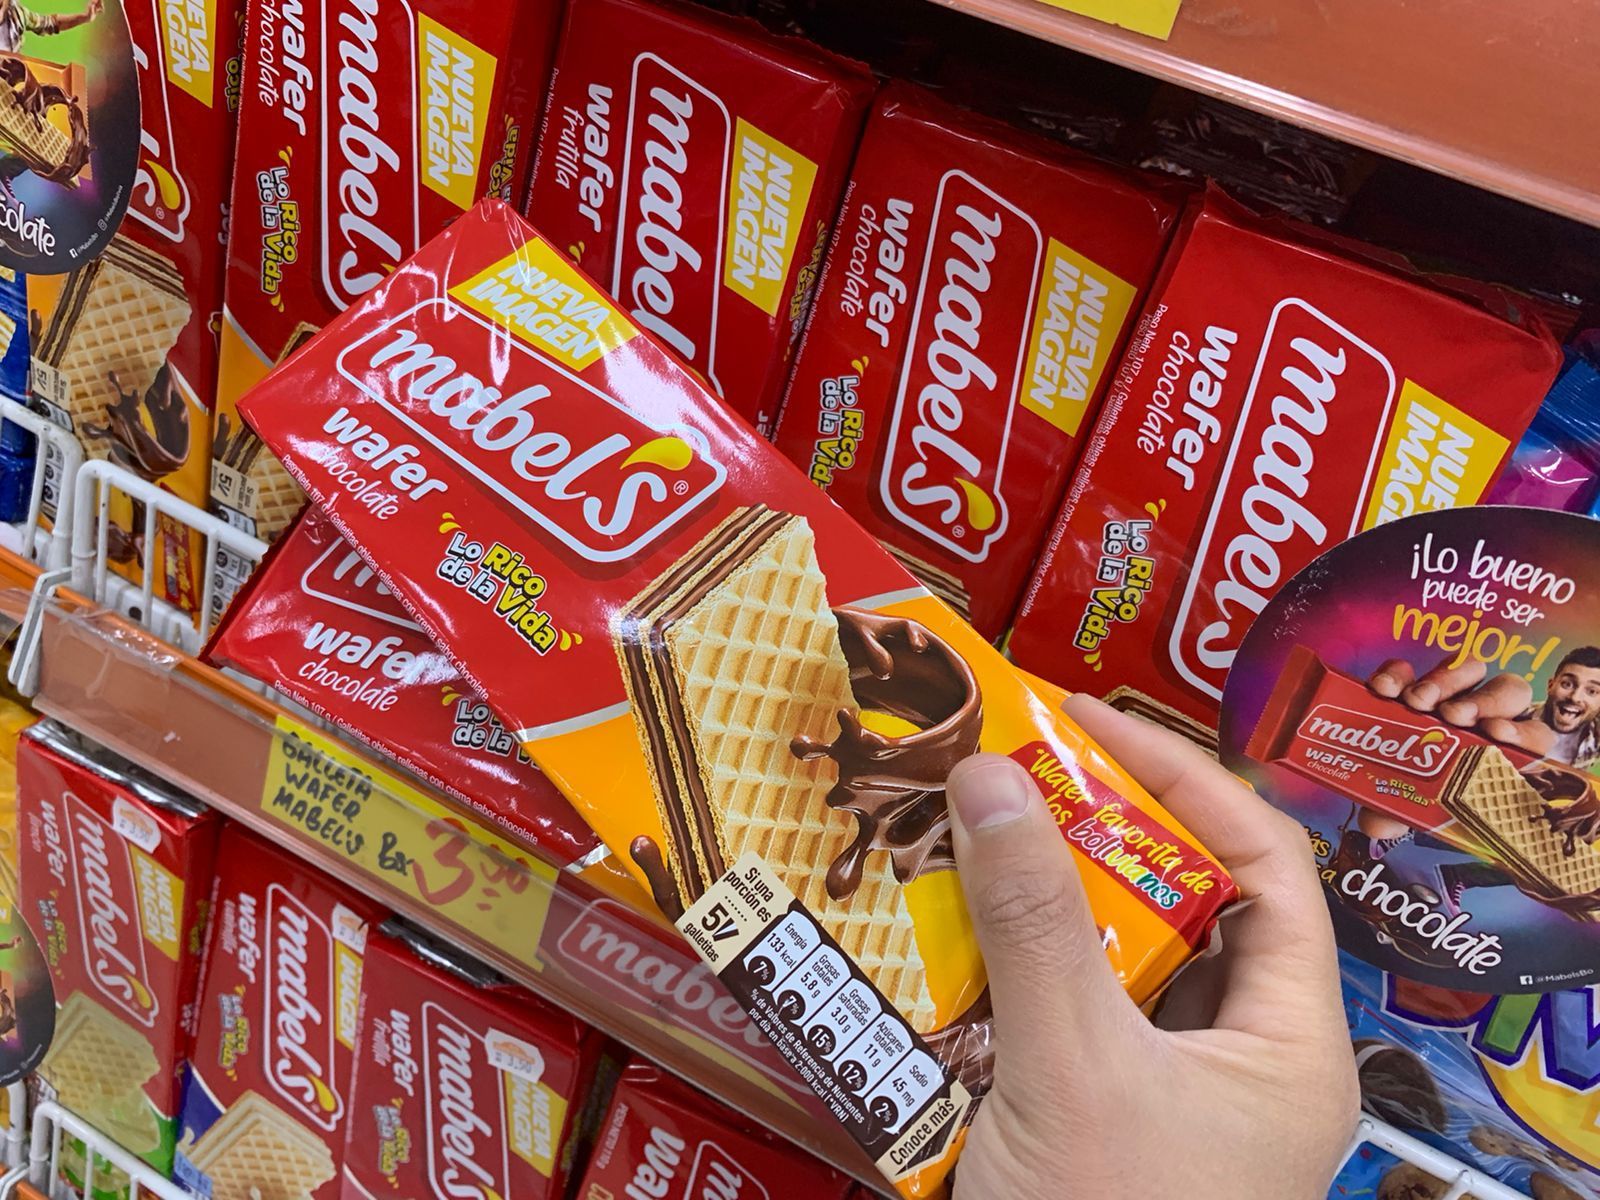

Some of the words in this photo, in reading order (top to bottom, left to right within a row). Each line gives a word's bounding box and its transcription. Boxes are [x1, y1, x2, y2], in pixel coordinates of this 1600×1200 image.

[426, 31, 449, 187] IMAGEN
[450, 46, 474, 177] NUEVA
[339, 0, 401, 296] mabels
[555, 105, 585, 190] frutilla
[579, 83, 614, 232] wafer
[257, 172, 276, 204] de
[270, 167, 290, 198] Lo
[731, 135, 762, 290] IMAGEN
[0, 202, 55, 256] colate
[262, 205, 279, 229] la
[278, 201, 299, 265] Rico
[631, 87, 702, 360] mabel
[759, 153, 793, 281] NUEVA
[261, 230, 285, 295] Vida
[841, 203, 876, 318] chocolate
[866, 198, 914, 348] wafer
[467, 279, 600, 361] IMAGEN
[498, 259, 613, 332] NUEVA
[1029, 255, 1075, 410] IMAGEN
[1061, 273, 1109, 404] NUEVA
[818, 411, 840, 434] la
[820, 378, 840, 411] de
[838, 376, 859, 407] Lo
[1138, 331, 1190, 455] chocolate
[1166, 324, 1239, 491] wafer
[322, 407, 448, 502] wafer
[369, 329, 694, 537] mabel's
[838, 408, 864, 469] Rico
[1375, 400, 1440, 528] IMAG
[1421, 422, 1474, 510] NUE
[446, 531, 483, 563] Lo
[483, 543, 548, 600] Rico
[1103, 521, 1128, 557] de
[1127, 519, 1152, 553] Lo
[1098, 557, 1125, 584] la
[1117, 556, 1154, 624] Rico
[1411, 532, 1459, 580] ¡Lo
[1468, 539, 1576, 605] bueno
[436, 558, 473, 588] de
[466, 571, 498, 604] la
[496, 587, 558, 655] Vida
[1075, 585, 1116, 652] Vida
[1422, 578, 1498, 612] puede
[1500, 598, 1545, 627] ser
[400, 596, 418, 615] con
[413, 611, 439, 640] crema
[434, 634, 460, 662] sabor
[453, 656, 494, 701] chocolate
[1392, 602, 1561, 684] mejor!
[298, 657, 399, 712] chocolate
[454, 698, 491, 725] Lo
[452, 722, 488, 750] de
[486, 726, 515, 757] la
[1305, 747, 1364, 773] wafer
[1308, 717, 1444, 768] mabel's
[285, 762, 361, 824] WAFER
[398, 753, 428, 780] rellenas
[429, 774, 445, 790] con
[445, 784, 472, 807] crema
[473, 799, 496, 819] sabor
[497, 811, 539, 845] chocolate
[1307, 760, 1350, 782] chocolate
[1375, 778, 1388, 786] Lo
[1389, 778, 1416, 792] Rico
[1375, 785, 1389, 794] de
[1390, 788, 1400, 796] la
[1402, 790, 1429, 808] Vida
[40, 800, 67, 888] wafer
[1068, 818, 1184, 910] bolivianos
[1092, 802, 1184, 872] favorita
[1179, 869, 1215, 895] de
[723, 871, 761, 910] porción
[757, 906, 772, 923] es
[745, 867, 761, 884] Si
[754, 880, 774, 902] una
[238, 892, 261, 984] wafer
[683, 922, 720, 963] galletitas
[784, 922, 808, 950] Energía
[1340, 863, 1503, 975] chocolate
[753, 960, 770, 980] 7%
[767, 932, 785, 953] 133
[780, 949, 797, 969] kcal
[811, 961, 834, 987] totales
[819, 953, 841, 980] Grasas
[579, 922, 772, 1047] mabe
[800, 971, 818, 991] 5.8
[811, 989, 821, 999] g
[838, 992, 868, 1026] saturadas
[849, 988, 871, 1015] Grasas
[811, 1028, 833, 1053] 15%
[831, 1006, 849, 1026] 3.0
[841, 1024, 851, 1034] g
[873, 1031, 896, 1057] totales
[876, 1020, 905, 1053] Azúcares
[390, 1009, 419, 1097] wafer
[748, 1007, 762, 1022] por
[759, 1018, 772, 1033] día
[768, 1030, 779, 1042] en
[776, 1038, 792, 1058] base
[811, 1078, 825, 1099] kcal
[756, 998, 767, 1010] de
[765, 1005, 788, 1035] Valores
[785, 1031, 796, 1044] de
[793, 1040, 825, 1079] Referencia
[823, 1076, 834, 1088] de
[831, 1084, 865, 1124] Nutrientes
[842, 1063, 864, 1089] 12%
[864, 1043, 878, 1059] 11
[871, 1058, 882, 1068] g
[908, 1064, 929, 1088] Sodio
[874, 1102, 893, 1122] 2%
[892, 1077, 908, 1093] 45
[901, 1091, 916, 1108] mg
[889, 1122, 933, 1165] Conoce
[929, 1099, 955, 1128] más
